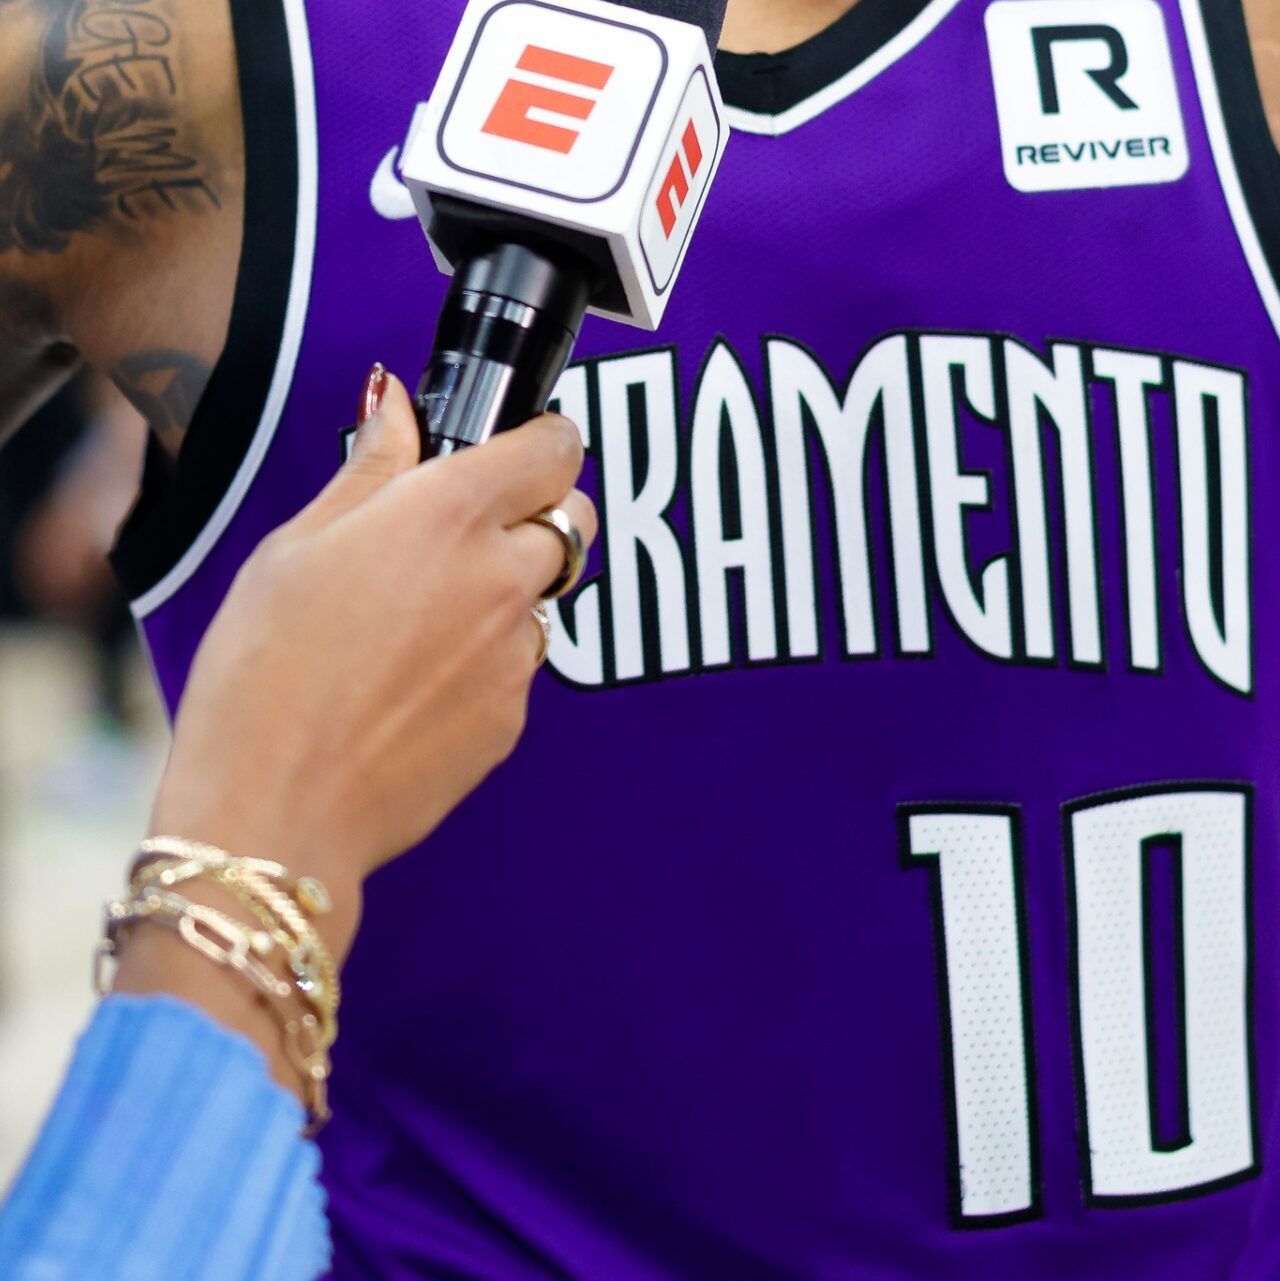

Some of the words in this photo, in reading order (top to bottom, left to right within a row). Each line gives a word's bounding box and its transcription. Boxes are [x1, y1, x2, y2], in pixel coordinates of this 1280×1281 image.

[1015, 135, 1173, 167] REVIVER
[1030, 23, 1141, 116] R
[339, 328, 1257, 702] CRAMENTO
[896, 779, 1262, 1231] 10
